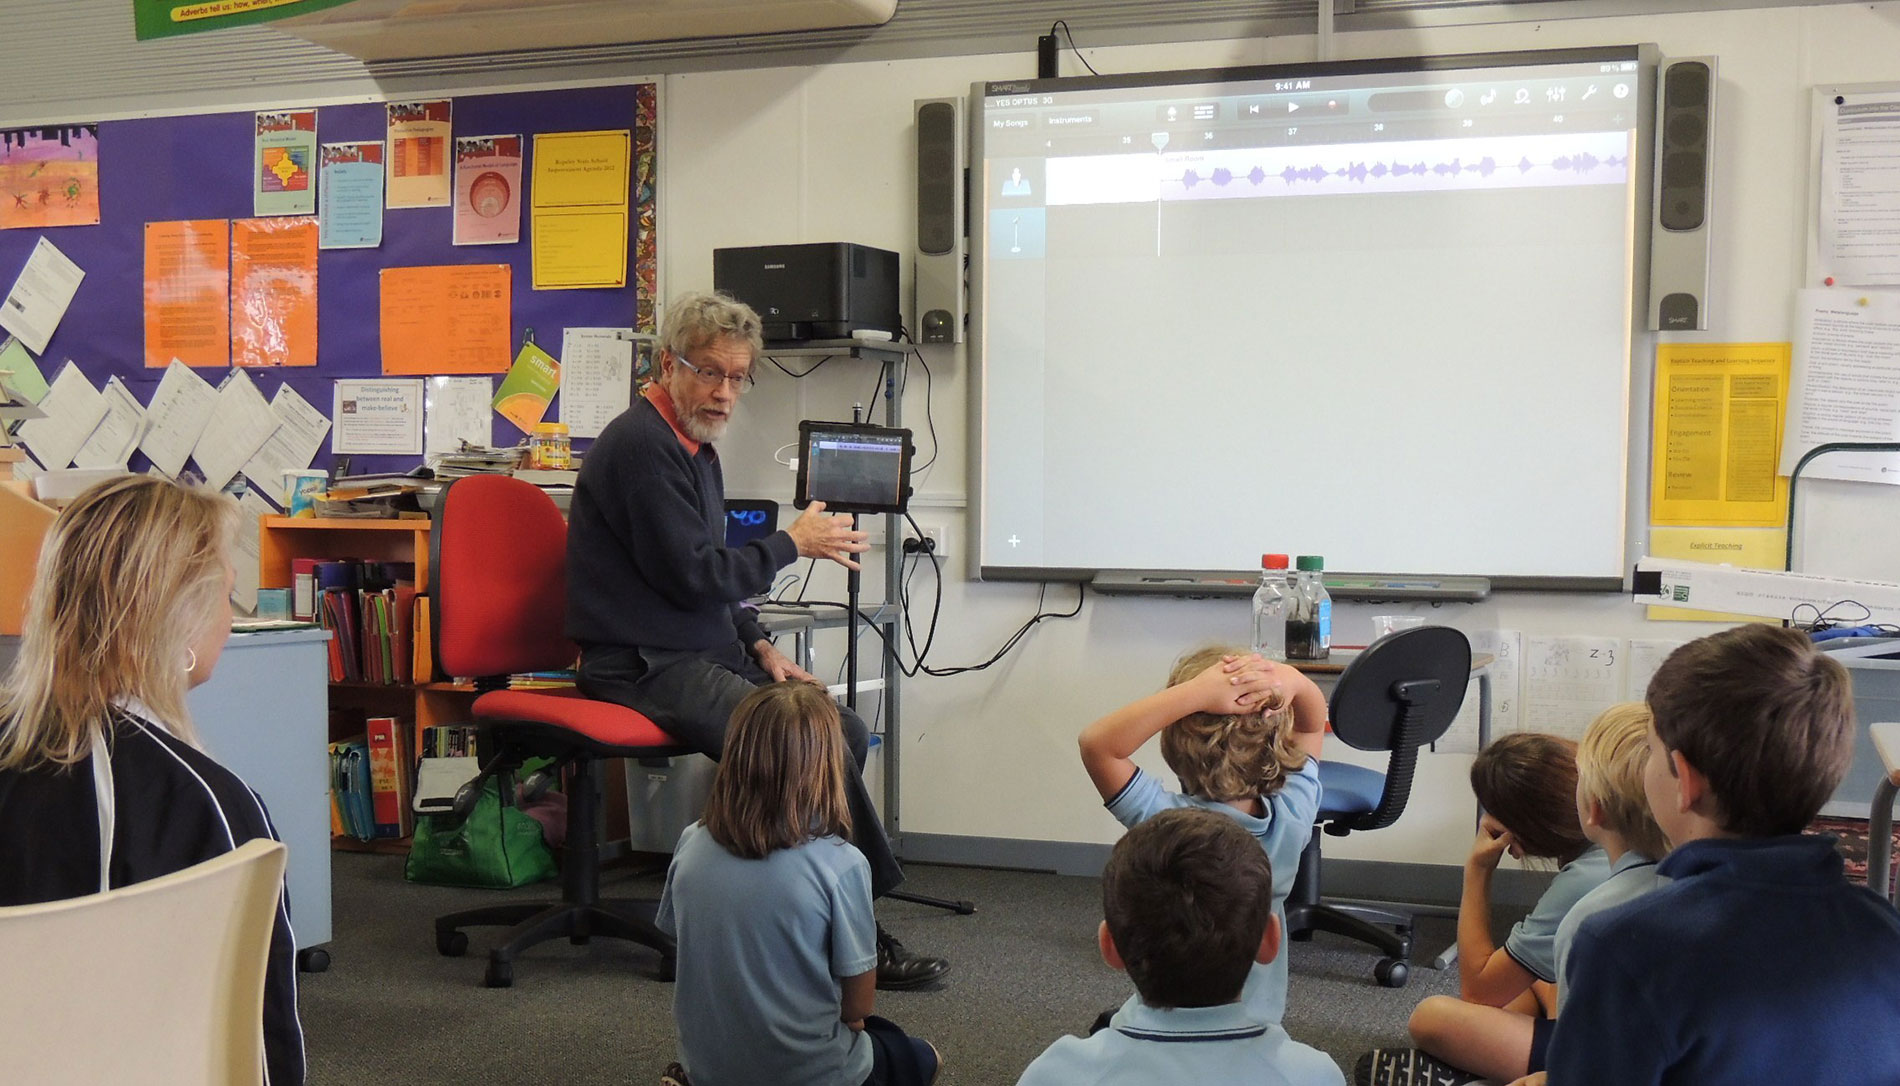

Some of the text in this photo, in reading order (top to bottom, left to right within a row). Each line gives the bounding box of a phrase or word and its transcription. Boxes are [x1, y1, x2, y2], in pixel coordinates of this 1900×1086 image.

[180, 8, 208, 17] Adverbs
[1275, 80, 1310, 92] 9:41 AM
[996, 99, 1010, 107] YES
[1012, 97, 1038, 106] OPTUS
[993, 118, 1028, 128] My Songs
[1048, 116, 1092, 124] Instruments
[1288, 128, 1298, 136] 37
[1553, 115, 1564, 123] 40
[530, 356, 556, 378] smart
[1670, 429, 1712, 438] Engagement
[1690, 542, 1743, 550] Explicit Teaching
